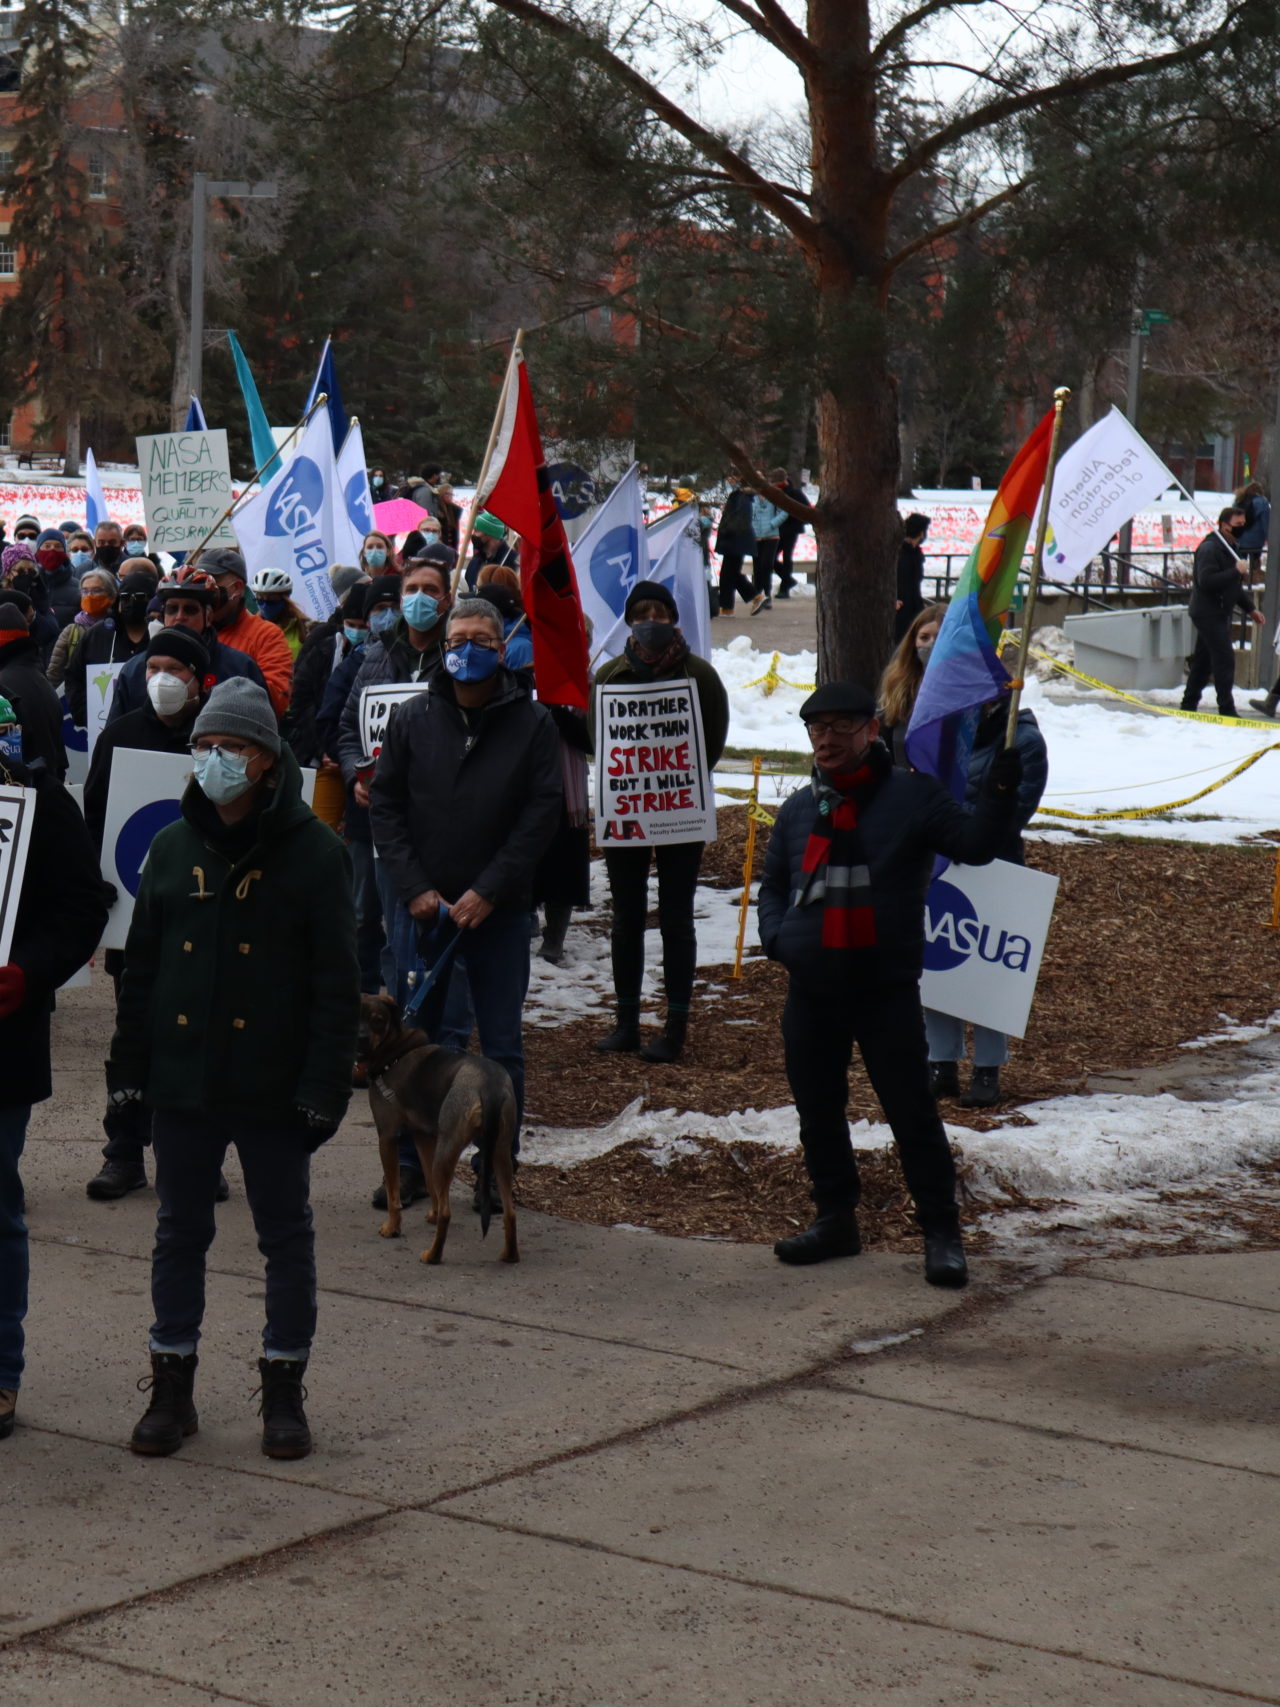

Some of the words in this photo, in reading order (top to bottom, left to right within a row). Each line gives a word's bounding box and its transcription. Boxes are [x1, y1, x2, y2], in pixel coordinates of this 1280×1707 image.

[150, 436, 212, 472] NASA
[148, 470, 229, 497] MEMBERS
[152, 507, 219, 522] QUALITY
[628, 697, 689, 717] RATHER
[370, 725, 385, 743] WO
[609, 723, 649, 740] WORK
[651, 719, 689, 738] THAN
[608, 741, 696, 777] STRIKE.
[610, 778, 639, 791] BUT
[644, 777, 651, 790] I
[657, 773, 695, 790] WILL
[614, 788, 698, 815] STRIKE.
[603, 820, 646, 840] AUFA
